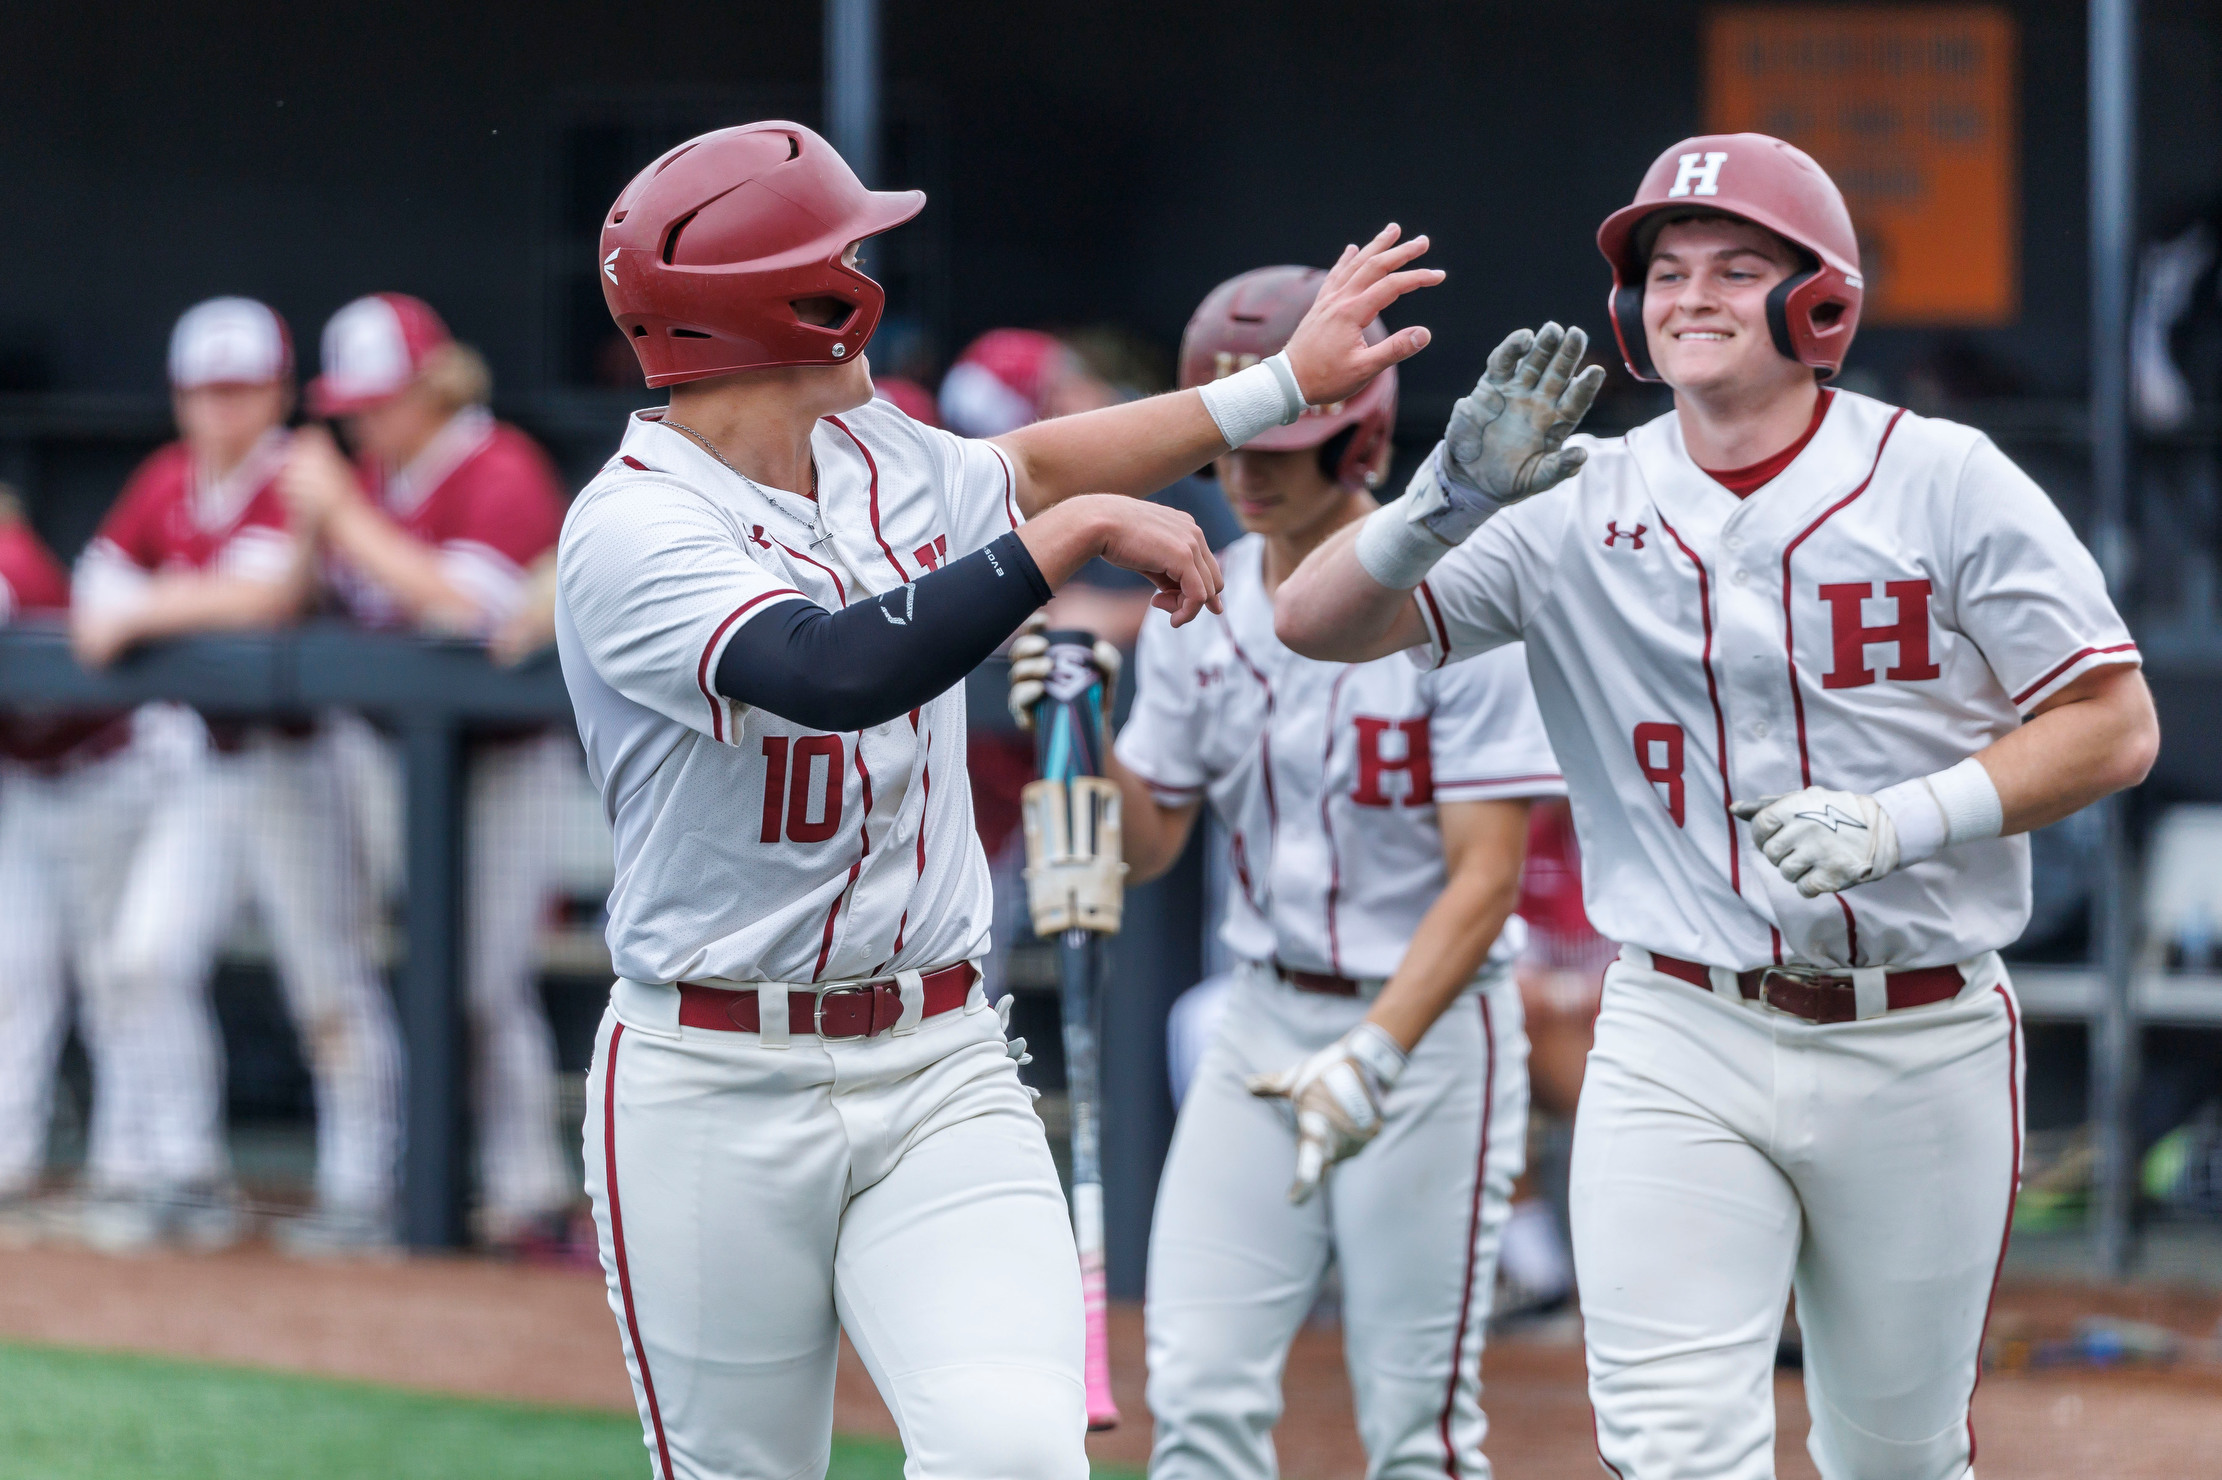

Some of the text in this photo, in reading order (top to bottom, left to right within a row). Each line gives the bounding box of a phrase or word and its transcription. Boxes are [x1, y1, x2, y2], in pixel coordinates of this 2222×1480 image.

[1668, 152, 1728, 198] H
[983, 545, 1005, 577] EVOS
[1818, 579, 1941, 689] H
[760, 734, 845, 843] 10
[1351, 716, 1434, 810] H
